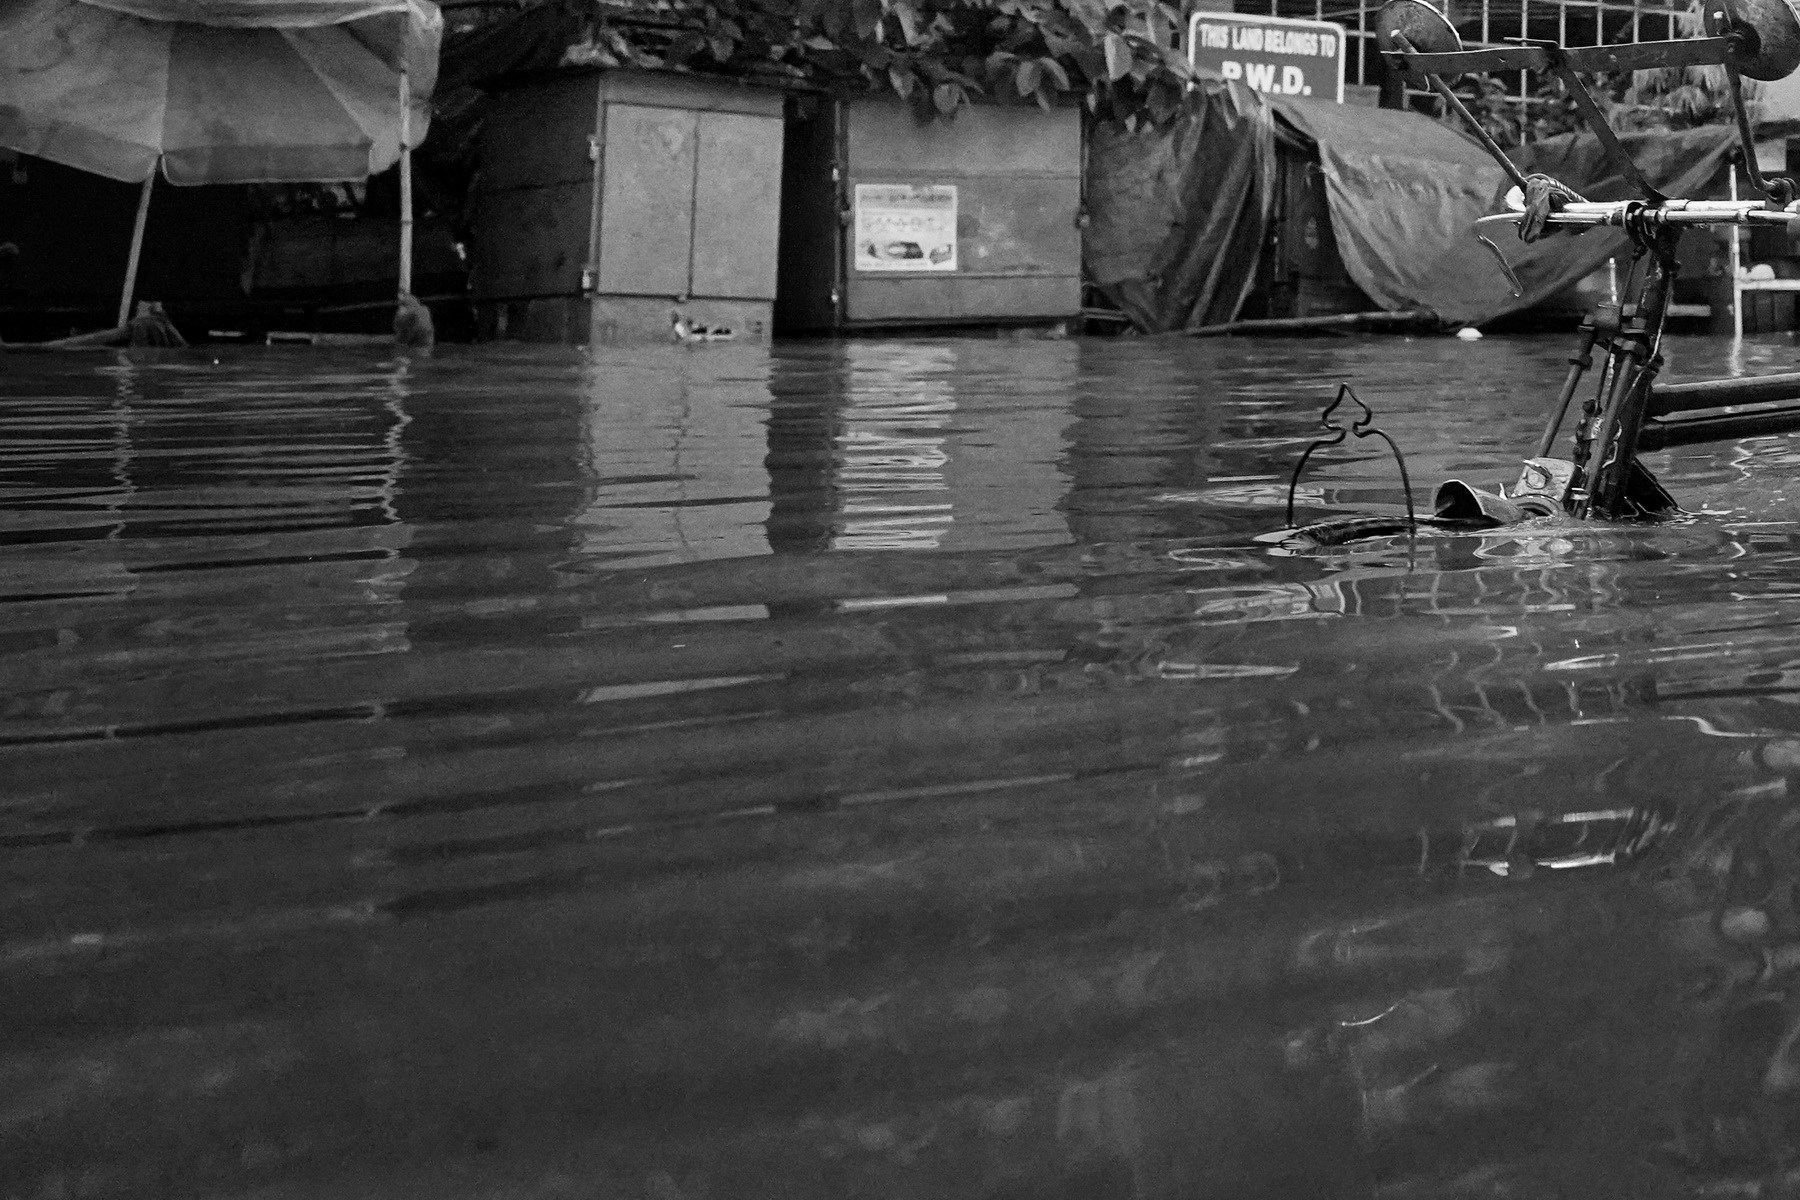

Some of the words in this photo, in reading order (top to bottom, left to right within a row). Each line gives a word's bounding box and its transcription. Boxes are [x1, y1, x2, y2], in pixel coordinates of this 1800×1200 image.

[1200, 24, 1228, 48] THIS
[1232, 26, 1263, 50] LAND
[1264, 30, 1318, 56] BELONGS
[1319, 34, 1336, 57] TO
[1221, 61, 1312, 96] PW.D.
